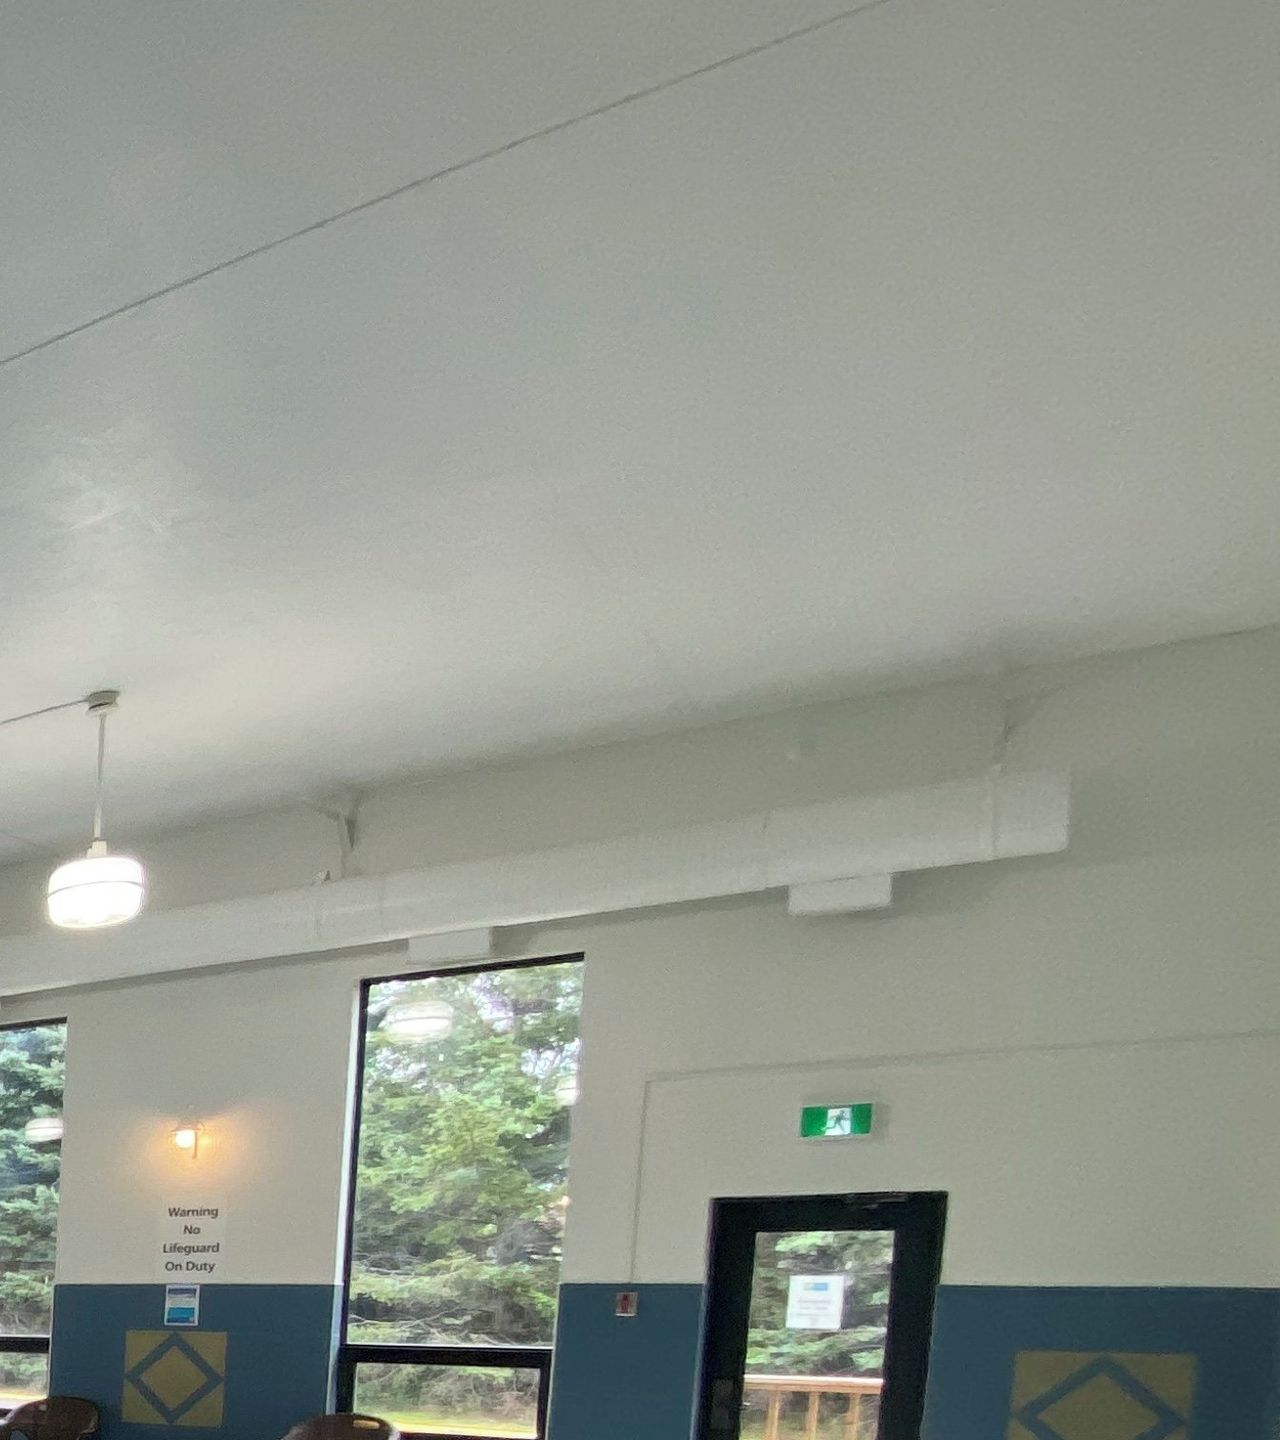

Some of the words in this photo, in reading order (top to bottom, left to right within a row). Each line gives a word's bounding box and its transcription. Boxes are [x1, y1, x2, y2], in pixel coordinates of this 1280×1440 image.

[168, 1207, 219, 1219] Warning
[183, 1225, 201, 1235] No
[162, 1242, 220, 1256] Lifeguard
[165, 1261, 183, 1272] On
[186, 1260, 216, 1274] Duty
